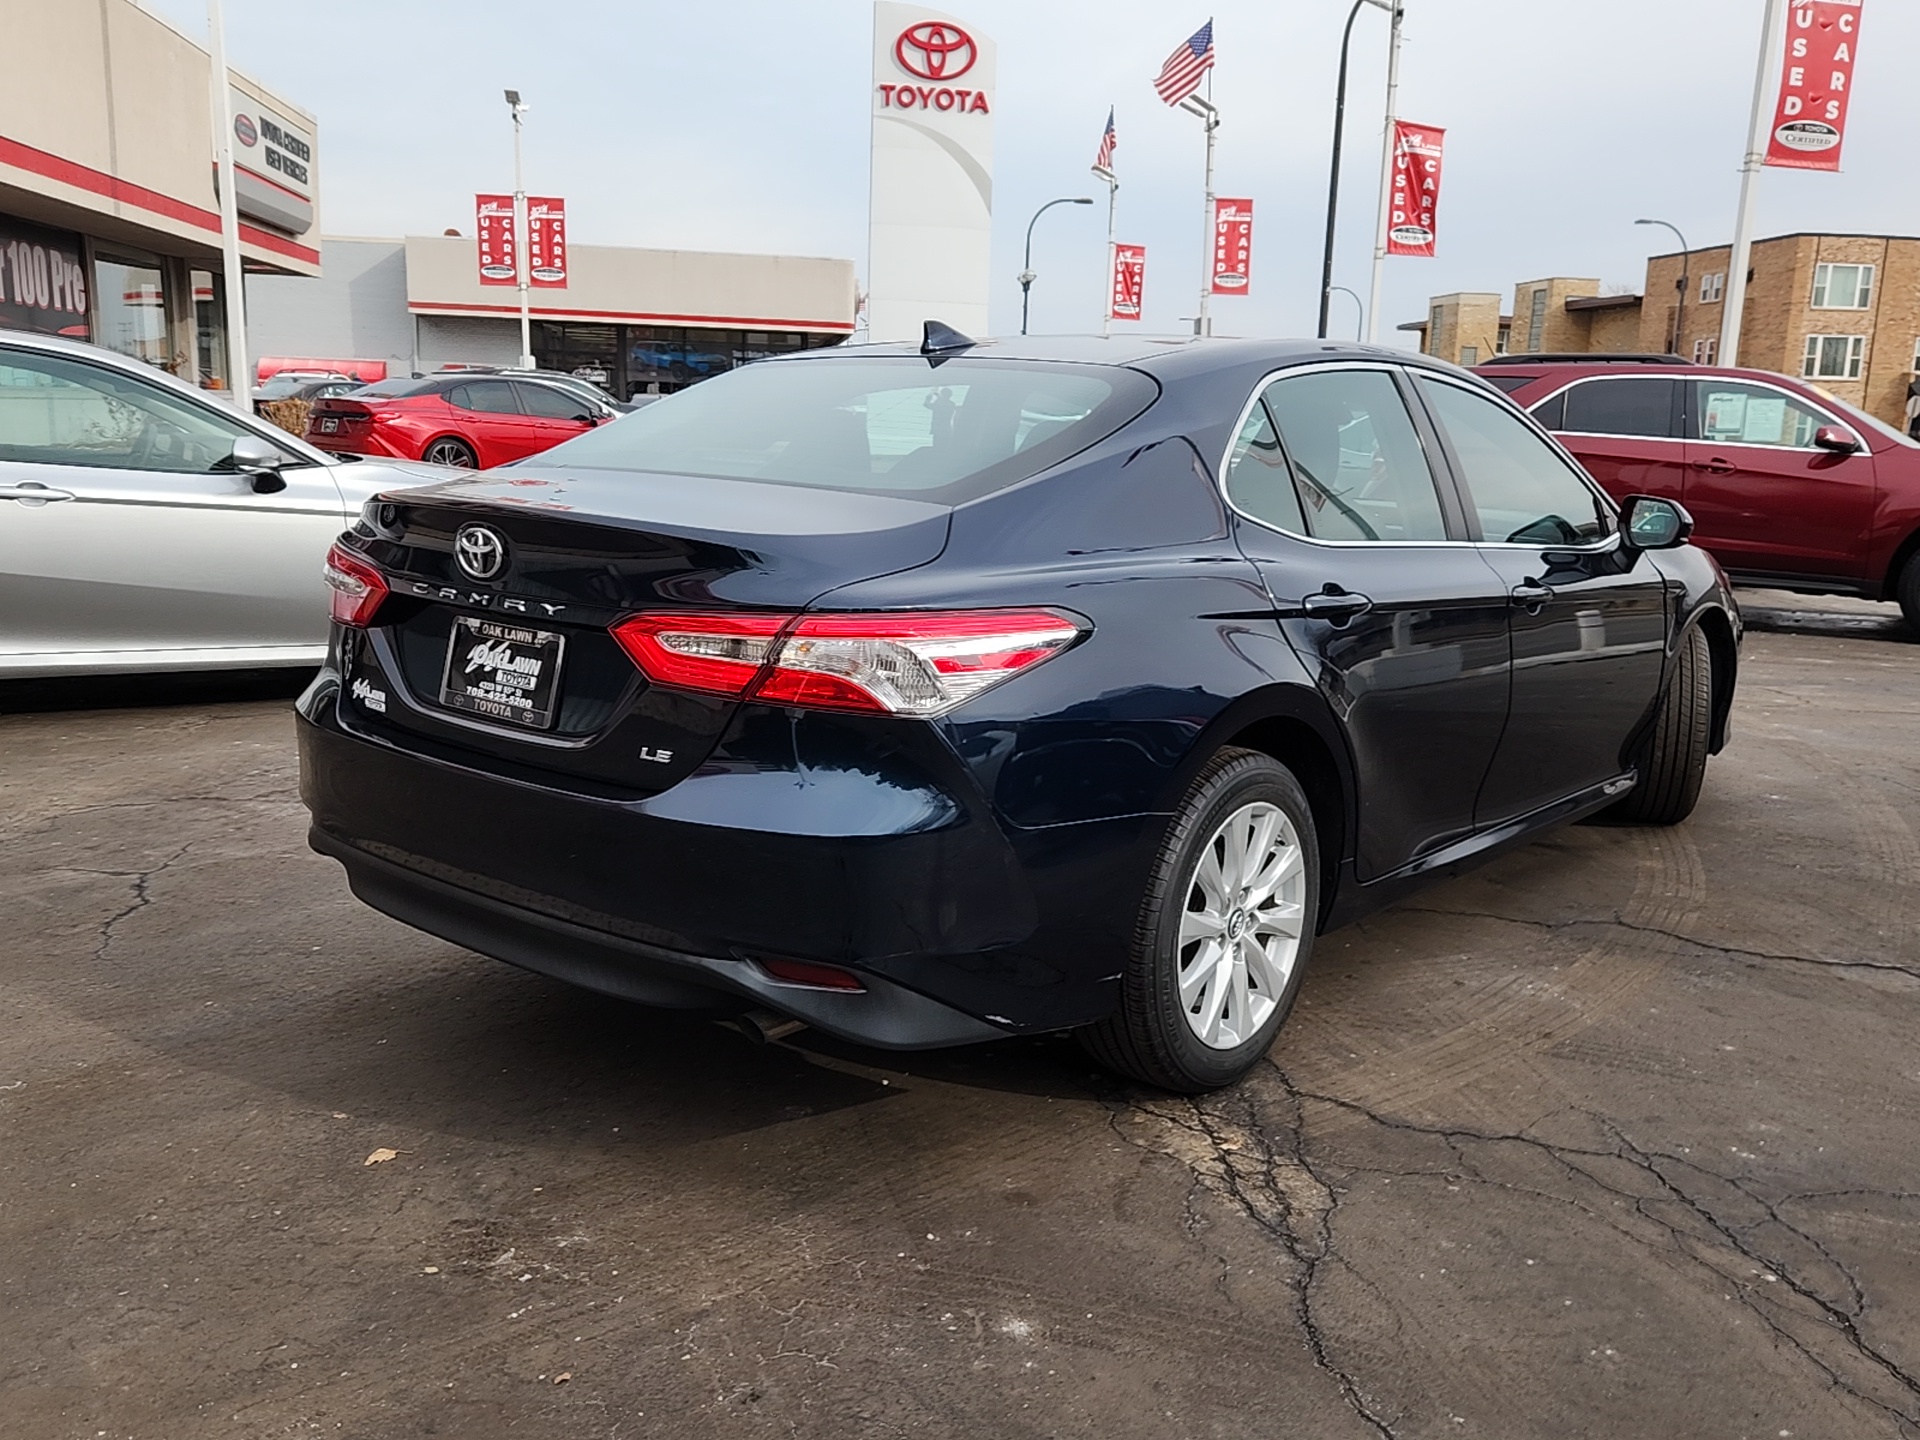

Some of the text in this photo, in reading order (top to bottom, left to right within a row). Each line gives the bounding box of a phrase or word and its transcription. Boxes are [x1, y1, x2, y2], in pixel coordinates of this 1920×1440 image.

[1784, 9, 1813, 116] USED
[1825, 13, 1854, 120] CARS
[879, 84, 989, 114] TOYOTA
[1392, 156, 1408, 223] USED
[1420, 160, 1437, 225] CARS
[480, 218, 492, 264] USED
[502, 219, 513, 265] CARS
[531, 221, 542, 266] USED
[552, 222, 563, 267] CARS
[1216, 223, 1228, 272] USED
[1237, 224, 1249, 273] CARS
[7, 240, 50, 310] 100
[49, 249, 87, 315] Pre
[1115, 263, 1125, 302] USED
[1131, 265, 1141, 303] CARS
[412, 582, 566, 616] CAMRY
[481, 623, 533, 643] OAK LAWN
[466, 686, 534, 708] 708-423-5200
[500, 671, 532, 688] TOYOTA
[473, 698, 512, 717] TOYOTA
[639, 746, 674, 764] LE
